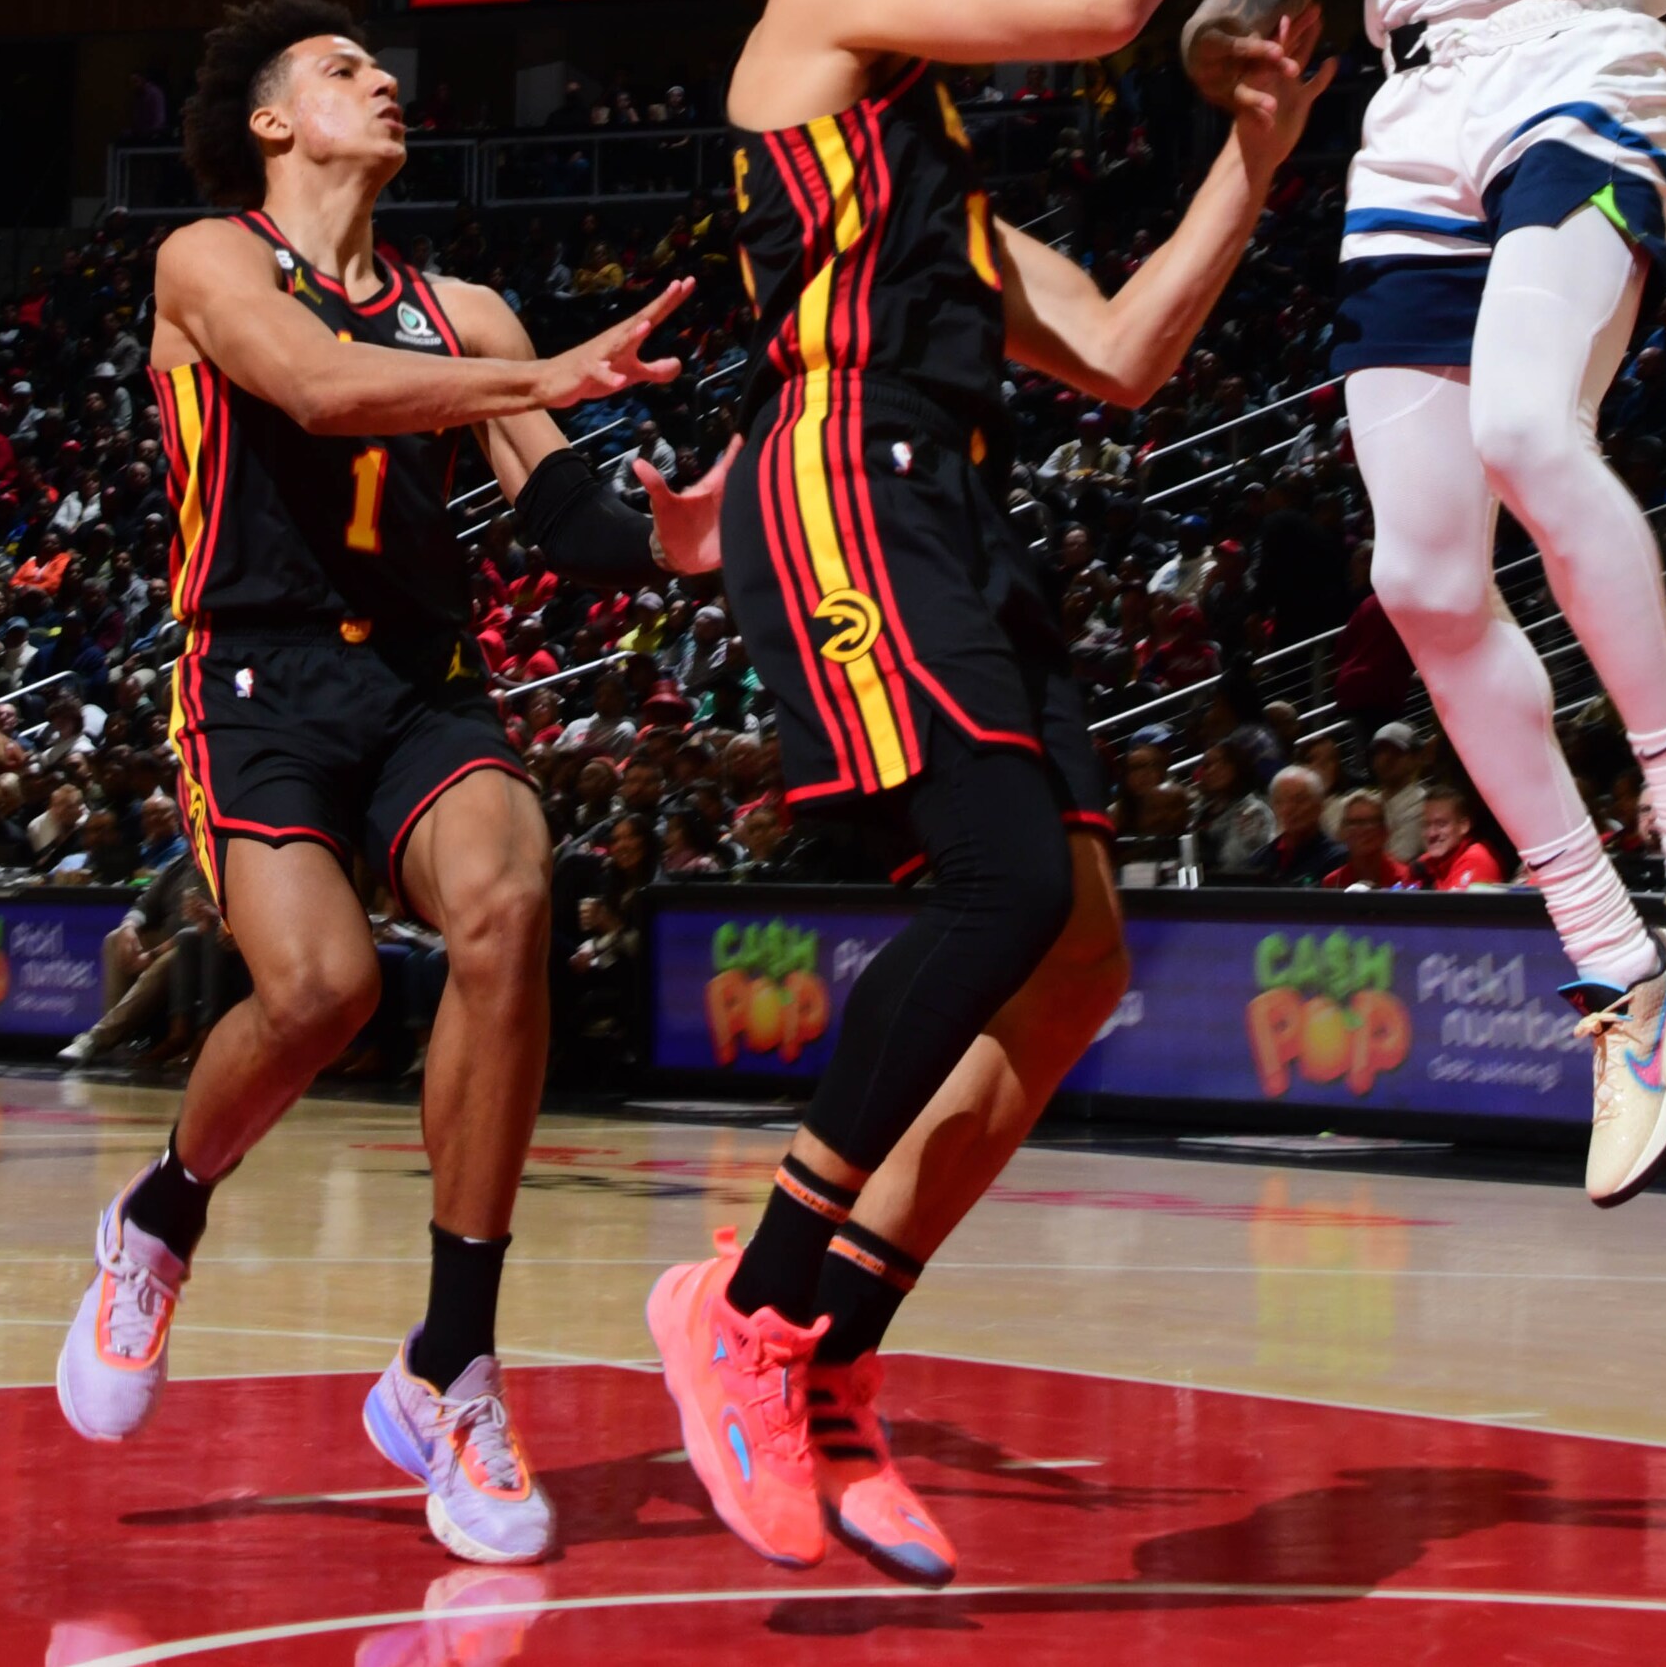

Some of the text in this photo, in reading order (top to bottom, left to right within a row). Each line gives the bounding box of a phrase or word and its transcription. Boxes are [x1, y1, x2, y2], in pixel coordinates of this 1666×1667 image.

[344, 446, 390, 554] 1
[1256, 929, 1395, 1000] CASH
[705, 969, 831, 1065] POP
[1246, 986, 1413, 1098] POP
